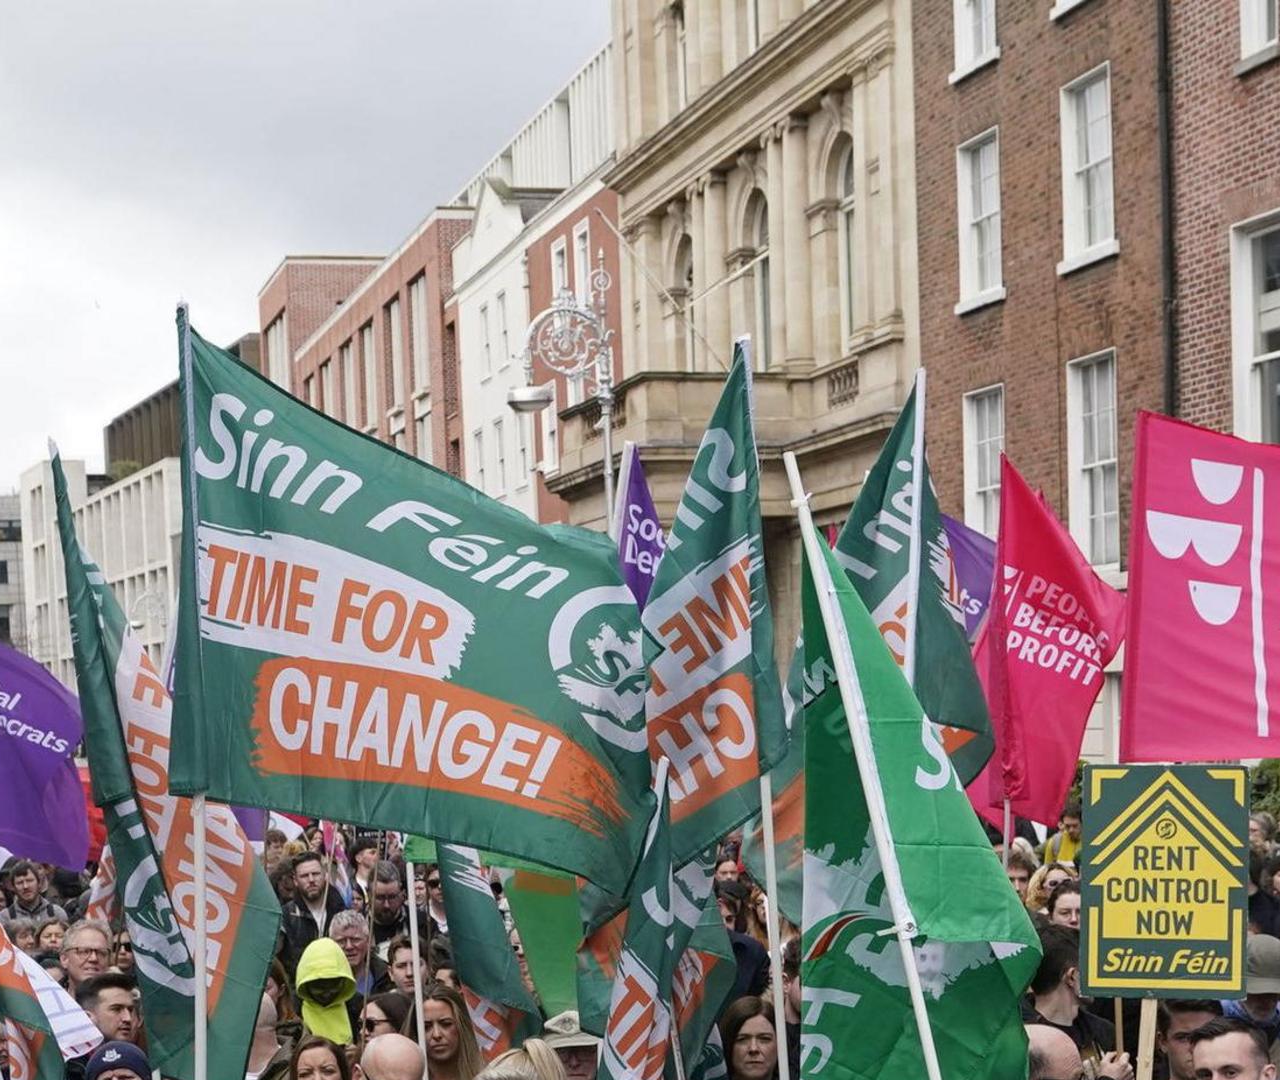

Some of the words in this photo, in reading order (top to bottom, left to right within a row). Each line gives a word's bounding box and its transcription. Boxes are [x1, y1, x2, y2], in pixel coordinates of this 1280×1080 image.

[195, 393, 363, 513] Sinn
[366, 500, 570, 599] Féin
[207, 543, 319, 636] TIME
[332, 578, 449, 666] FOR
[1007, 631, 1102, 686] PROFIT
[269, 667, 562, 798] CHANGE!
[1133, 846, 1200, 871] RENT
[1106, 877, 1225, 904] CONTROL
[1136, 910, 1194, 935] NOW
[1103, 948, 1164, 973] Sinn
[1169, 949, 1229, 974] Féin
